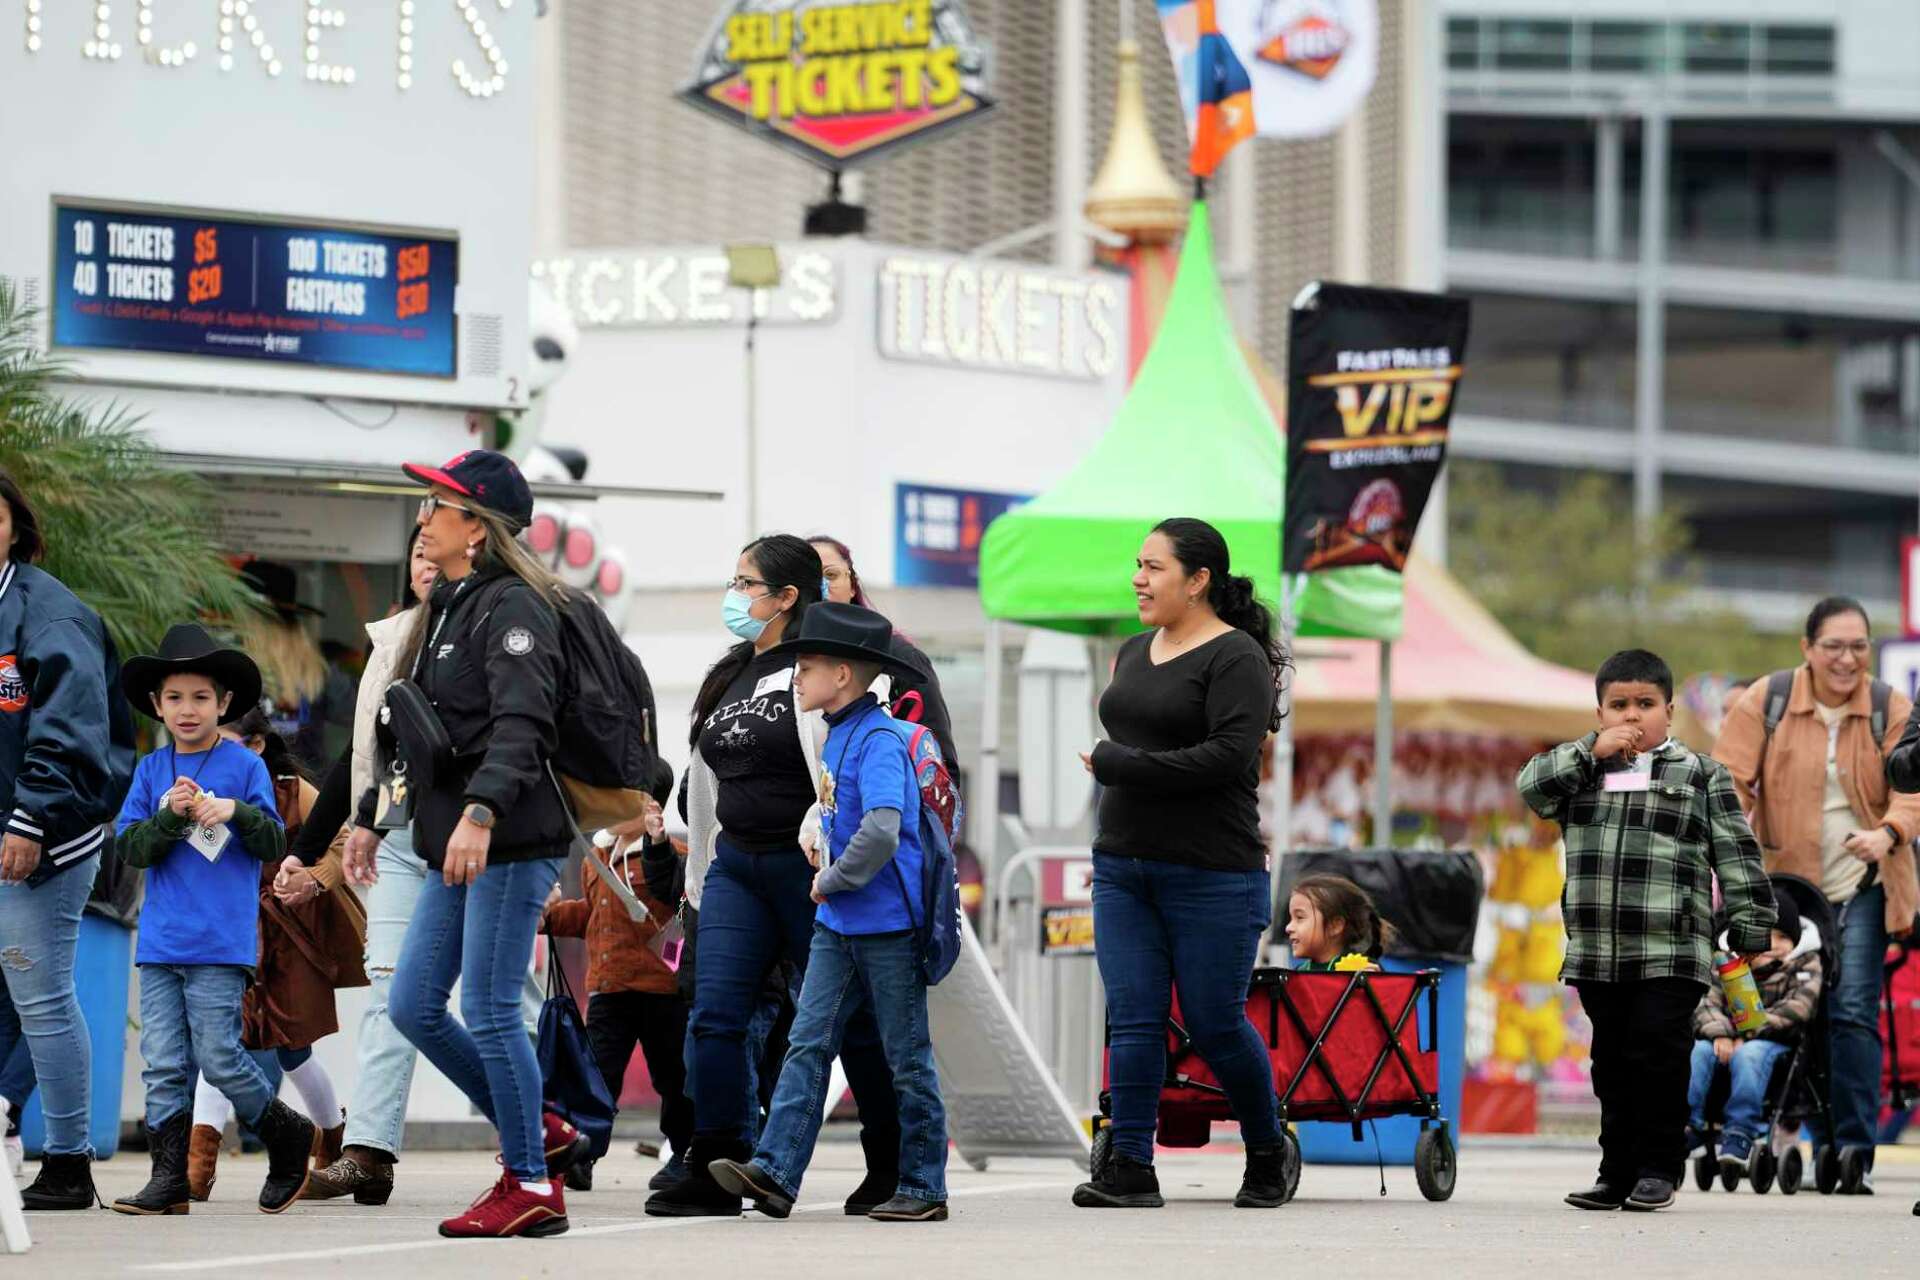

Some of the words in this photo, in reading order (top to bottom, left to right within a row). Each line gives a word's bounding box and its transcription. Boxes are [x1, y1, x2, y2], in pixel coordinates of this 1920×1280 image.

[726, 10, 796, 61] SELF
[803, 0, 933, 53] SERVICE
[743, 46, 961, 121] TICKETS
[73, 220, 95, 256] 10
[106, 222, 175, 263] TICKETS
[194, 227, 218, 265] $5
[287, 237, 317, 272] 100
[322, 239, 388, 279] TICKETS
[72, 261, 97, 297] 40
[106, 263, 175, 303] TICKETS
[188, 264, 223, 306] $20
[286, 276, 366, 317] FASTPASS
[882, 258, 1117, 377] TICKETS
[1336, 381, 1451, 437] VIP
[704, 697, 788, 729] TEXAS
